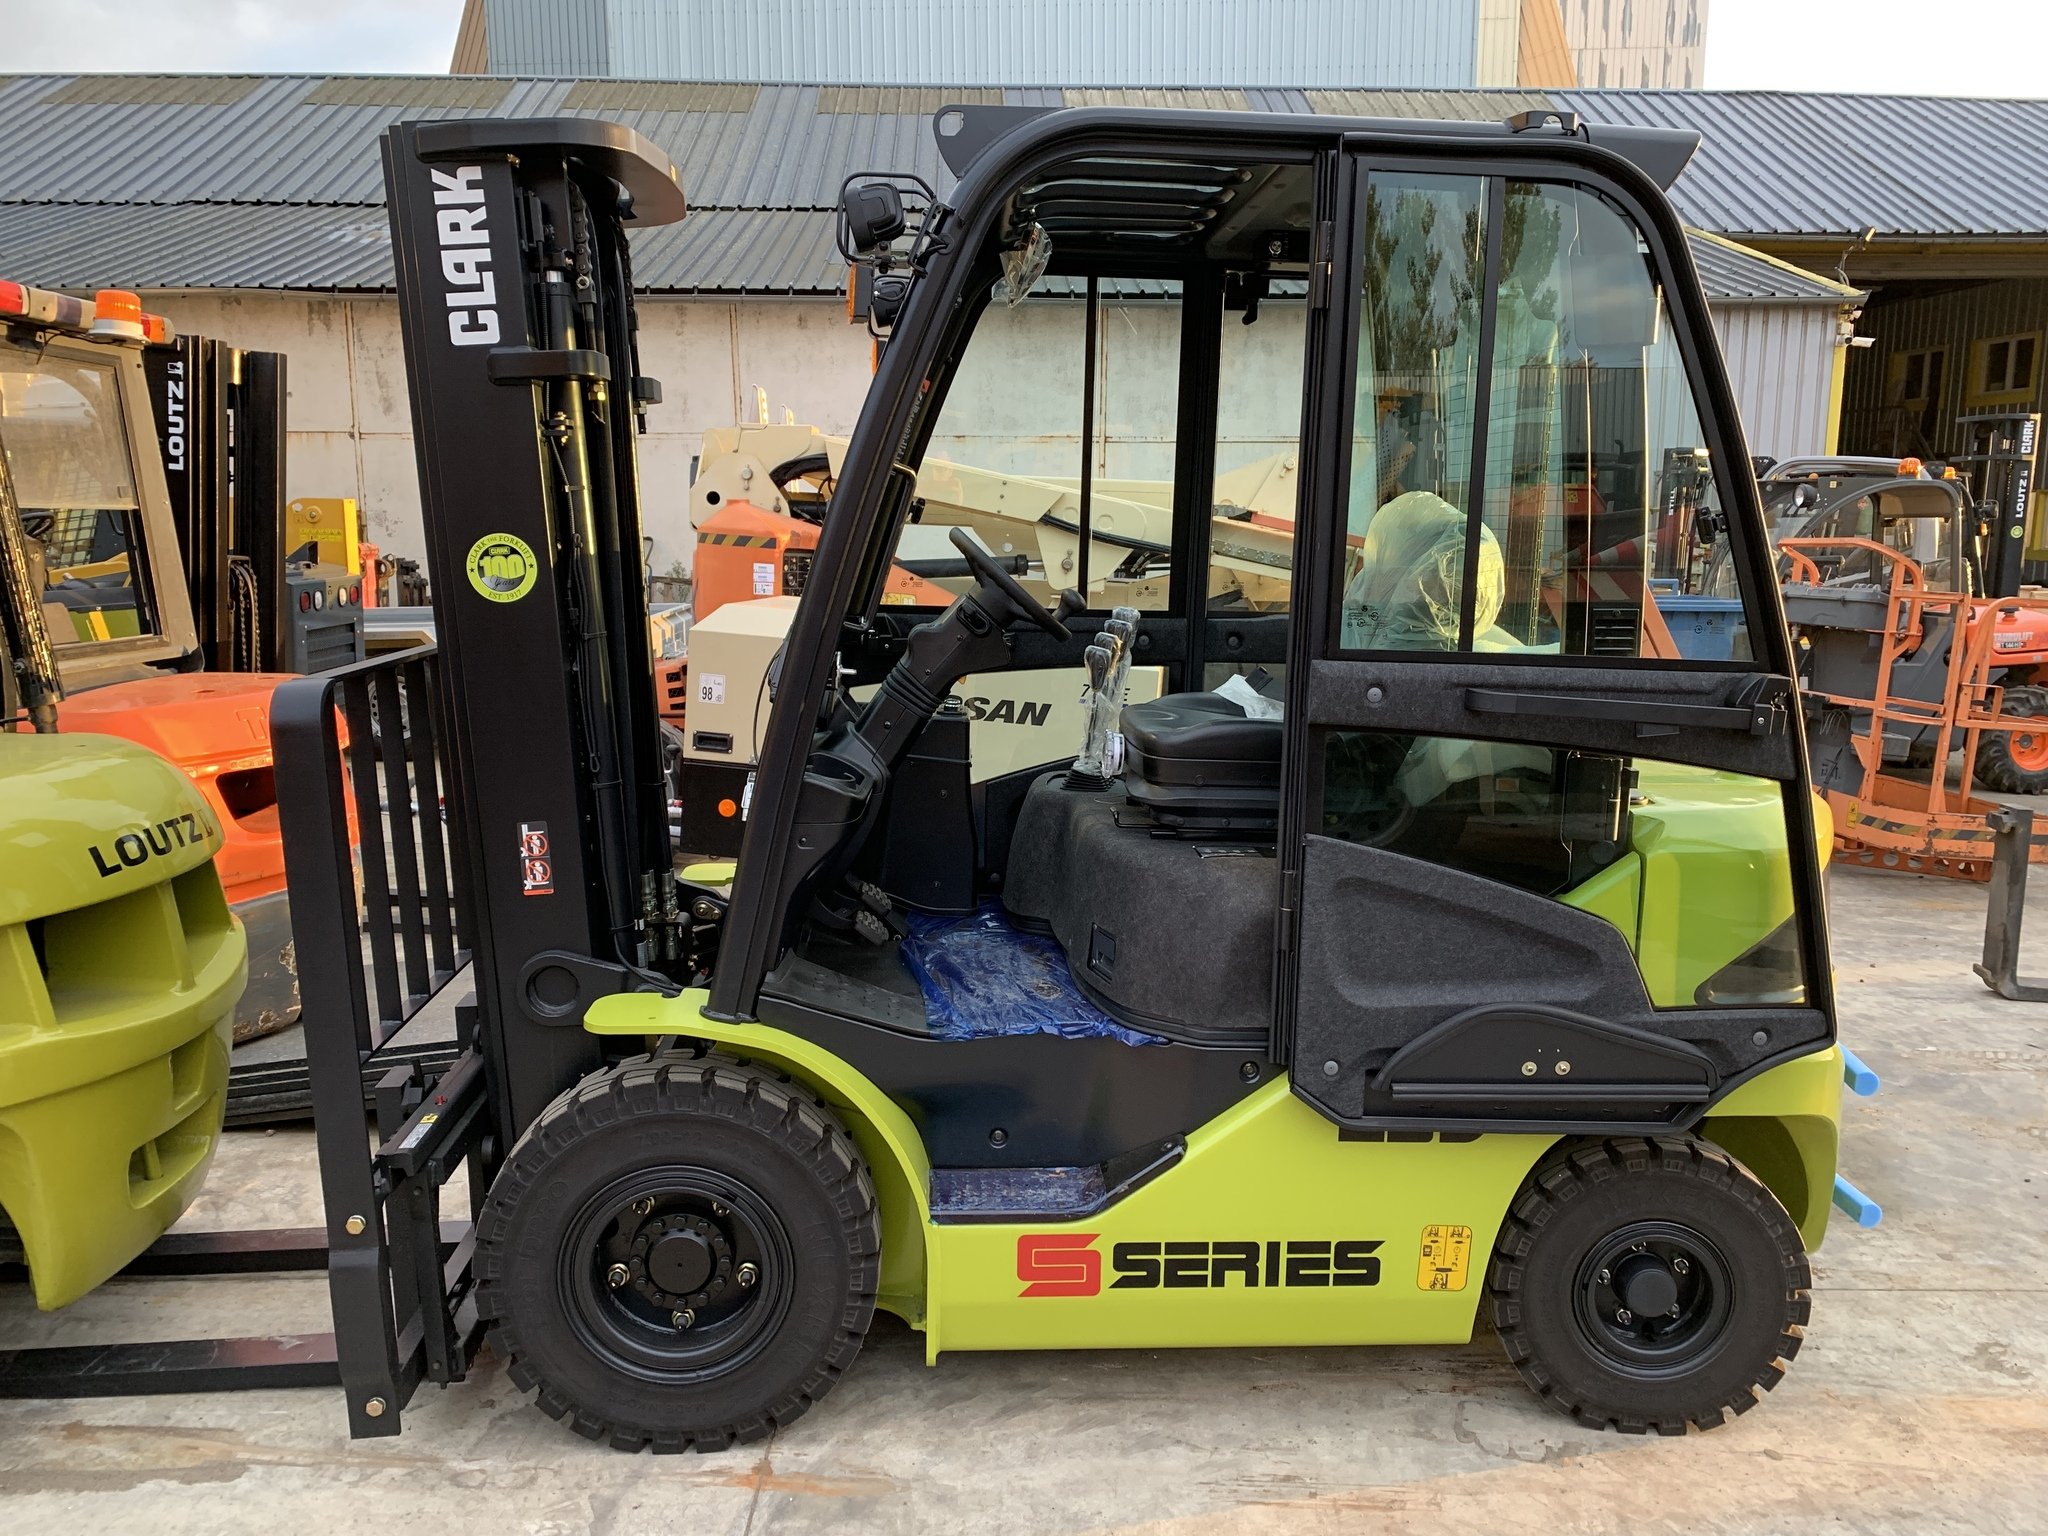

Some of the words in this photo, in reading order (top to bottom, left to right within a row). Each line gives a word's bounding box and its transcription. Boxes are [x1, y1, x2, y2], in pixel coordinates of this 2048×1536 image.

[431, 165, 500, 346] CLARK
[168, 380, 184, 471] LOUTZ
[2021, 420, 2035, 454] CLARK
[2015, 478, 2028, 518] LOUTZ
[469, 541, 487, 564] CLARK
[499, 535, 533, 560] FORKLIFT
[478, 553, 526, 579] 100
[506, 589, 522, 600] 1917
[702, 686, 713, 700] 98
[88, 813, 203, 878] LOUTZ
[1017, 1233, 1101, 1297] S
[1108, 1240, 1386, 1288] SERIES
